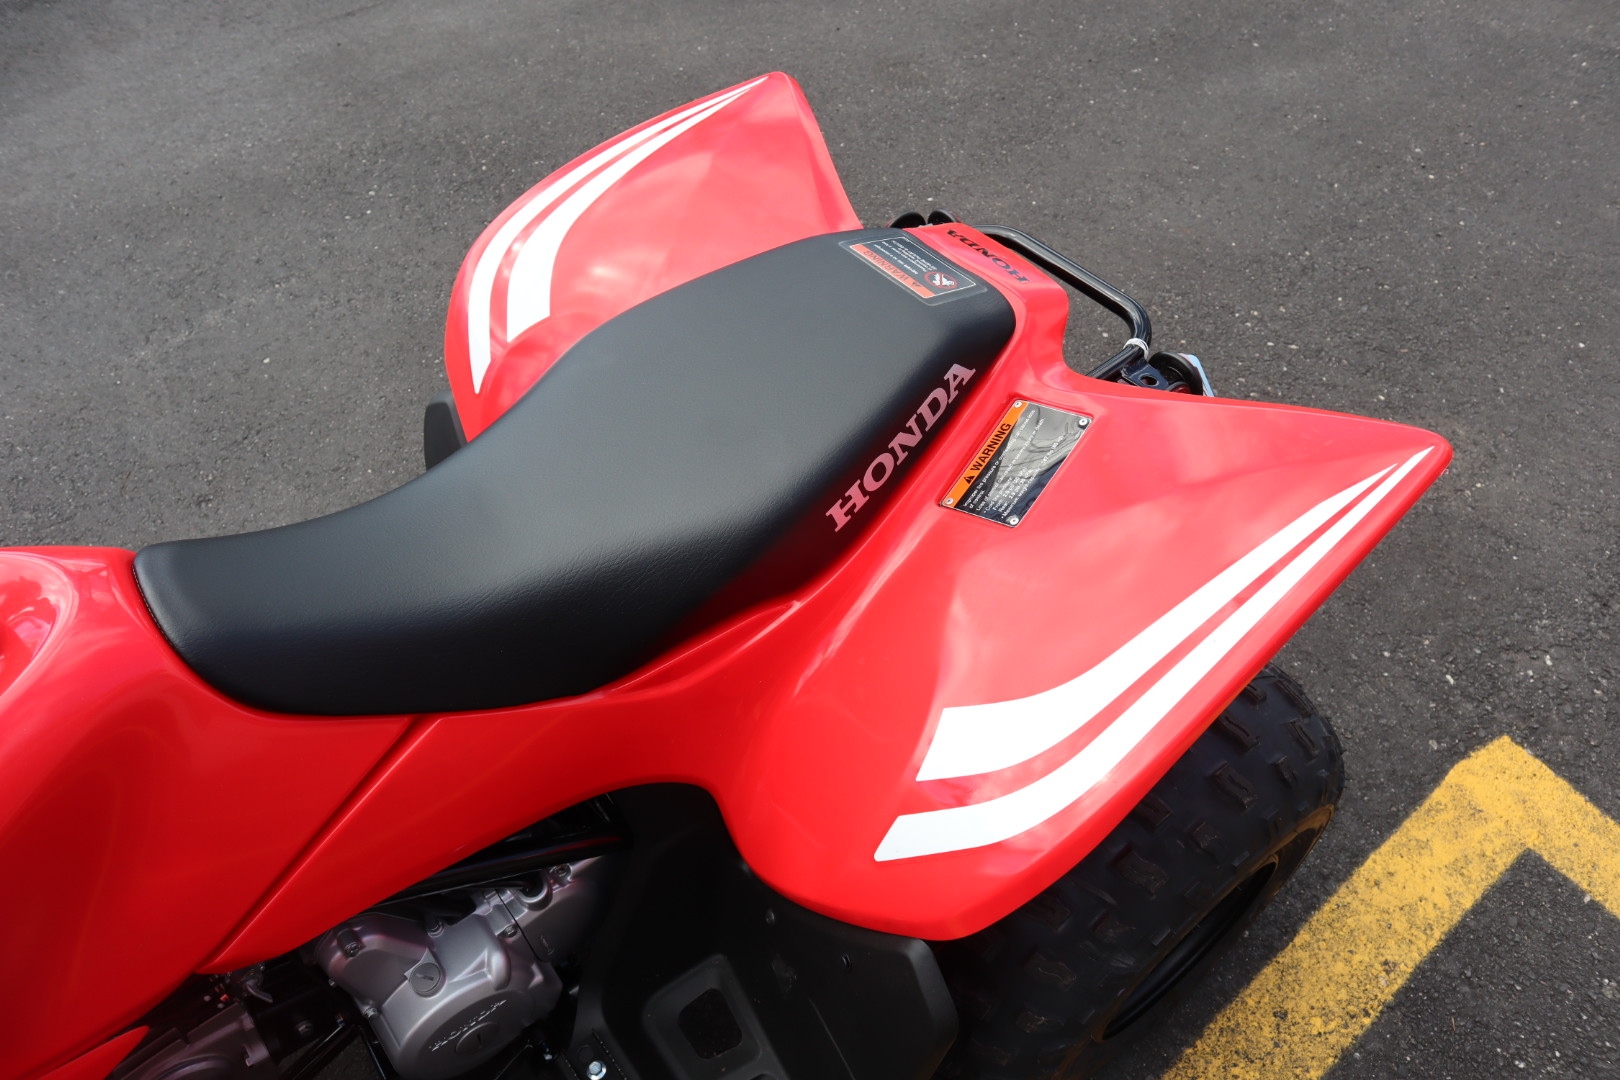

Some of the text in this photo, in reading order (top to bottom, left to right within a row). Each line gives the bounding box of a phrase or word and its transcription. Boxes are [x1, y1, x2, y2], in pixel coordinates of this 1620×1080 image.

[863, 251, 909, 280] WARNING
[946, 228, 1030, 284] HONDA
[825, 363, 976, 532] HONDA
[970, 423, 1012, 471] WARNING
